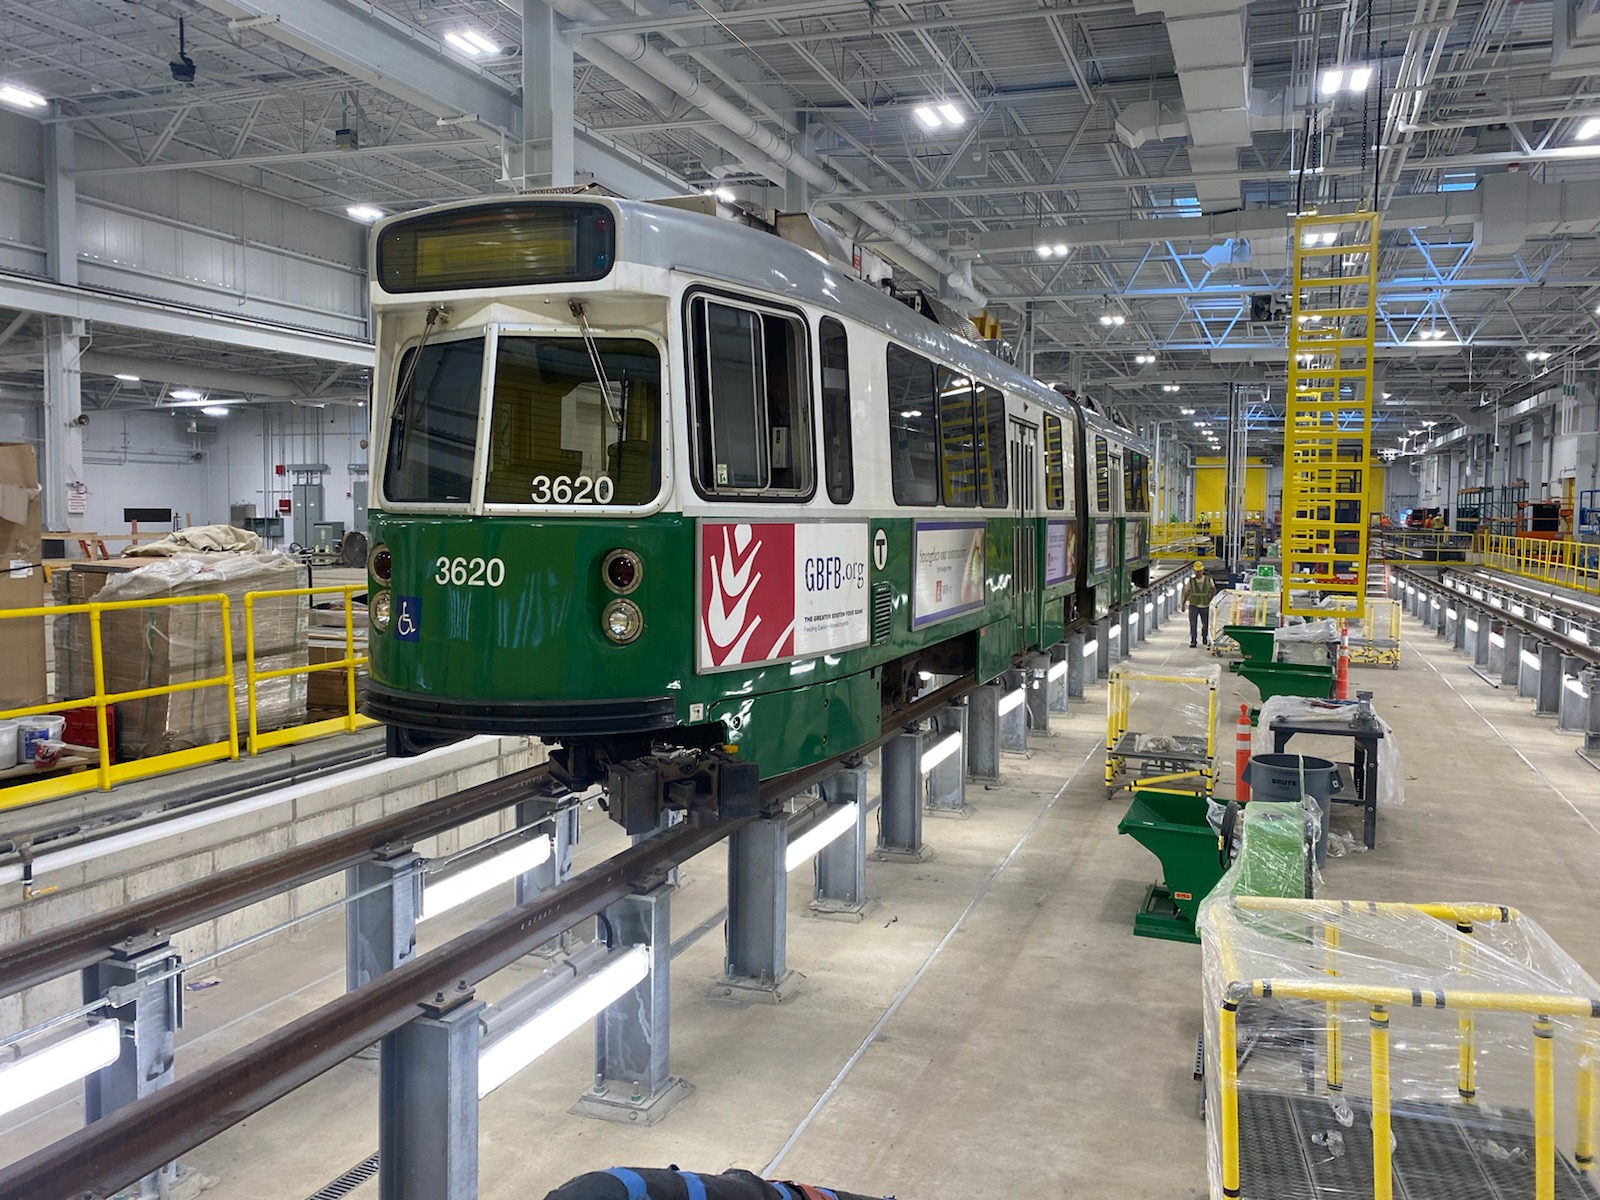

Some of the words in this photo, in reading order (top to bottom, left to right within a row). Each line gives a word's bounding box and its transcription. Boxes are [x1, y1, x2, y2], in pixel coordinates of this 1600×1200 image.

[531, 475, 615, 504] 3620
[435, 557, 505, 587] 3620
[805, 556, 864, 592] GBFB.org
[813, 613, 831, 622] GREATER
[831, 611, 845, 619] BOSTON
[1272, 778, 1298, 786] BRUTE
